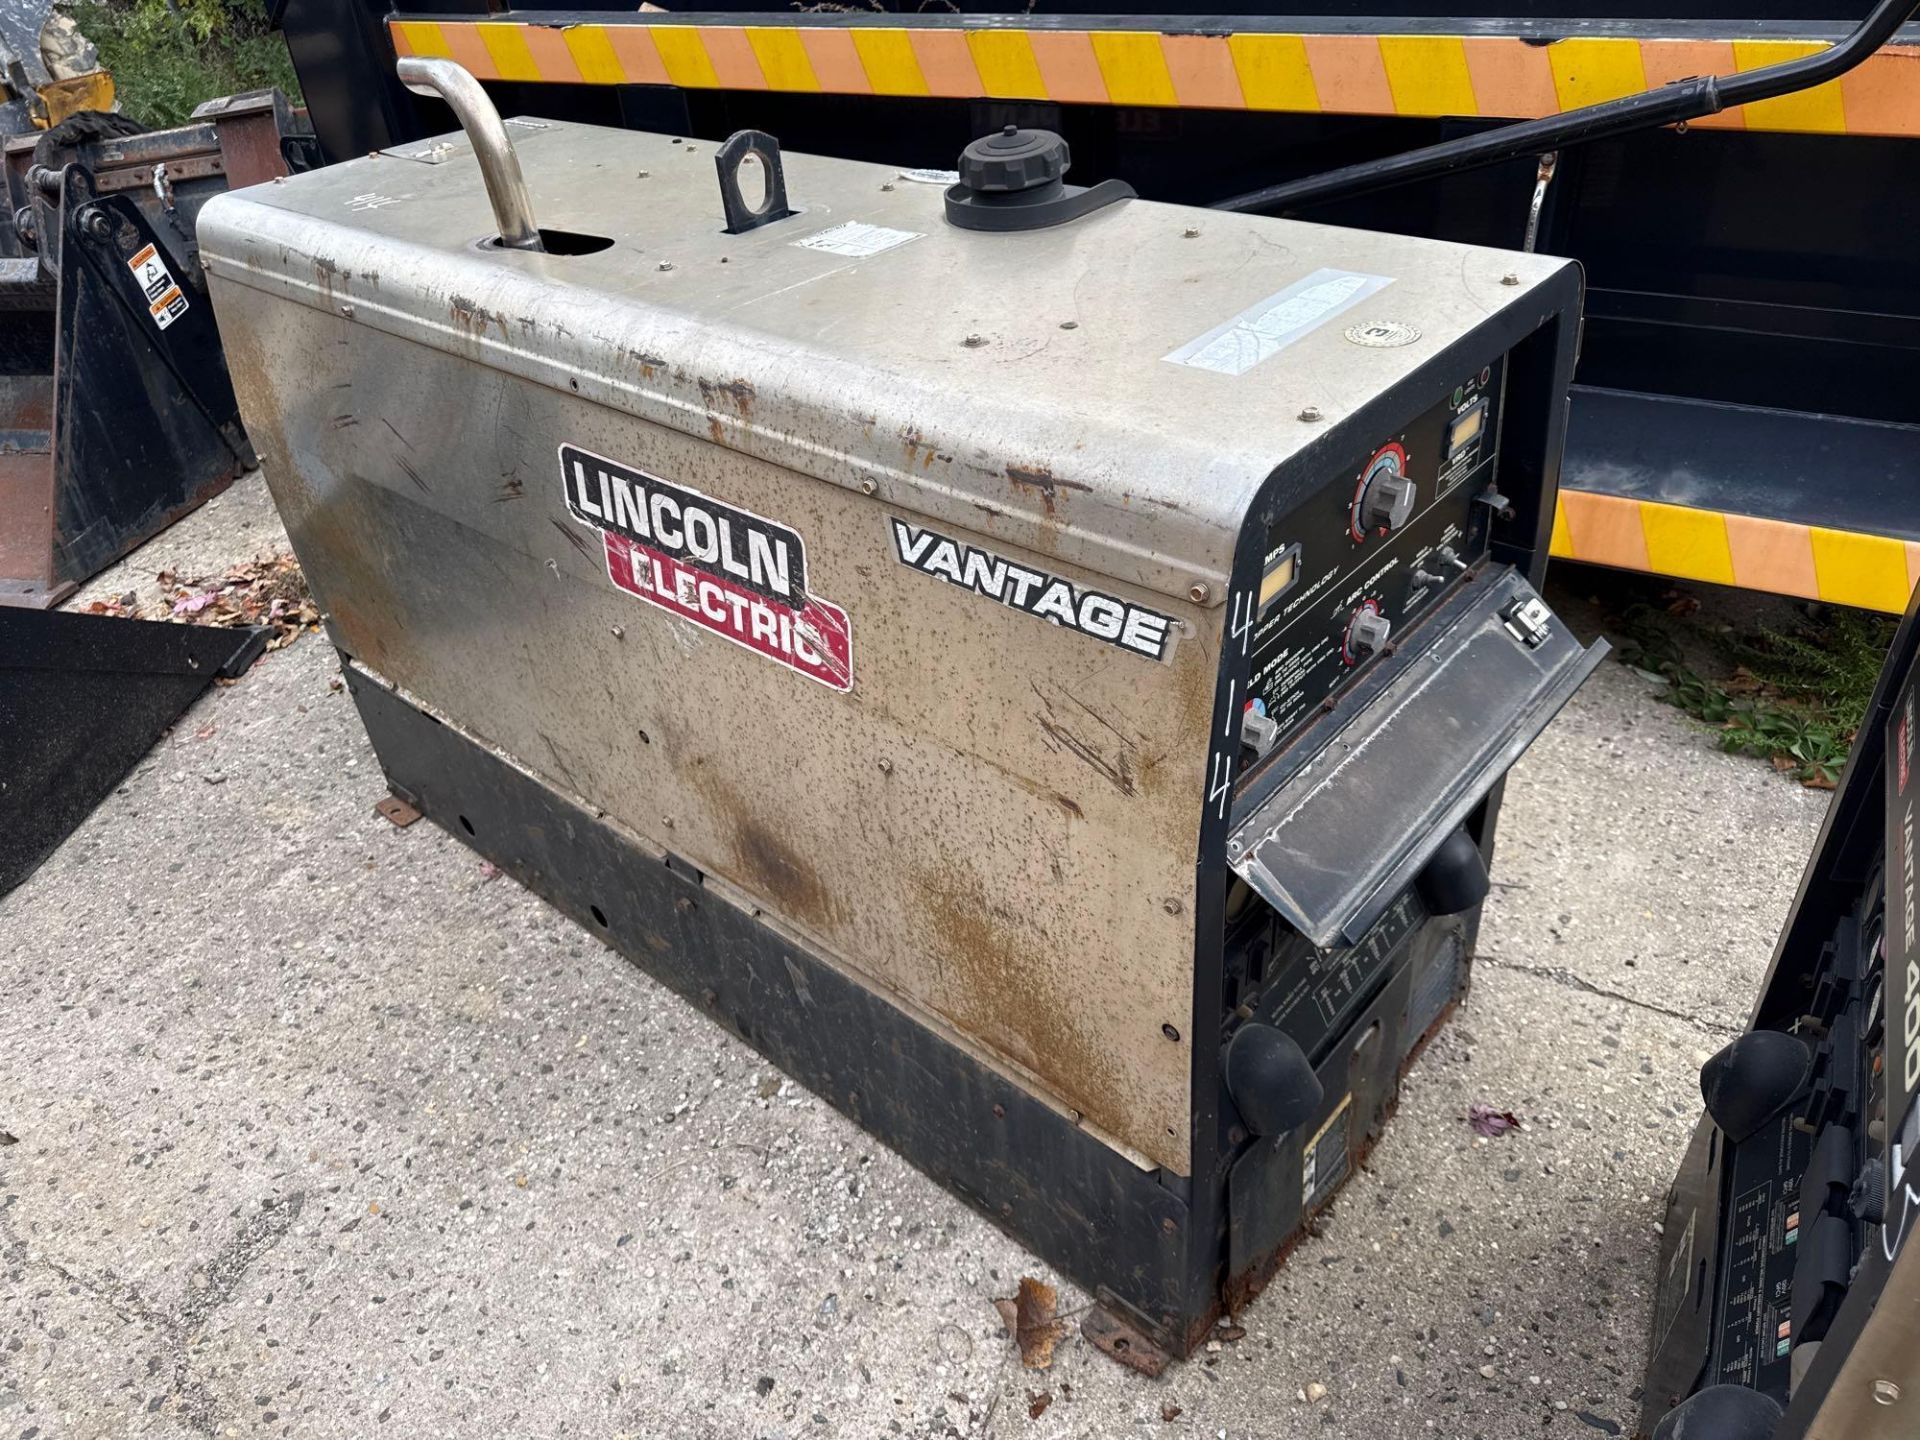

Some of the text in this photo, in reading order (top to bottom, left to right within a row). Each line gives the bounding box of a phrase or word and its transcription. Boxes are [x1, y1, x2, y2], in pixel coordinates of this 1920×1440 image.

[1457, 393, 1479, 415] VOLTS
[573, 461, 789, 595] LINCOLN
[1263, 543, 1286, 566] MPS
[628, 546, 825, 667] ELECTRIC
[894, 521, 1171, 658] VANTAGE
[1282, 565, 1340, 617] TECHNOLOGY
[1346, 587, 1363, 606] ARC
[1363, 557, 1400, 590] CONTROL
[1262, 647, 1290, 676] MODE
[1903, 798, 1920, 1093] VANTAGE 400
